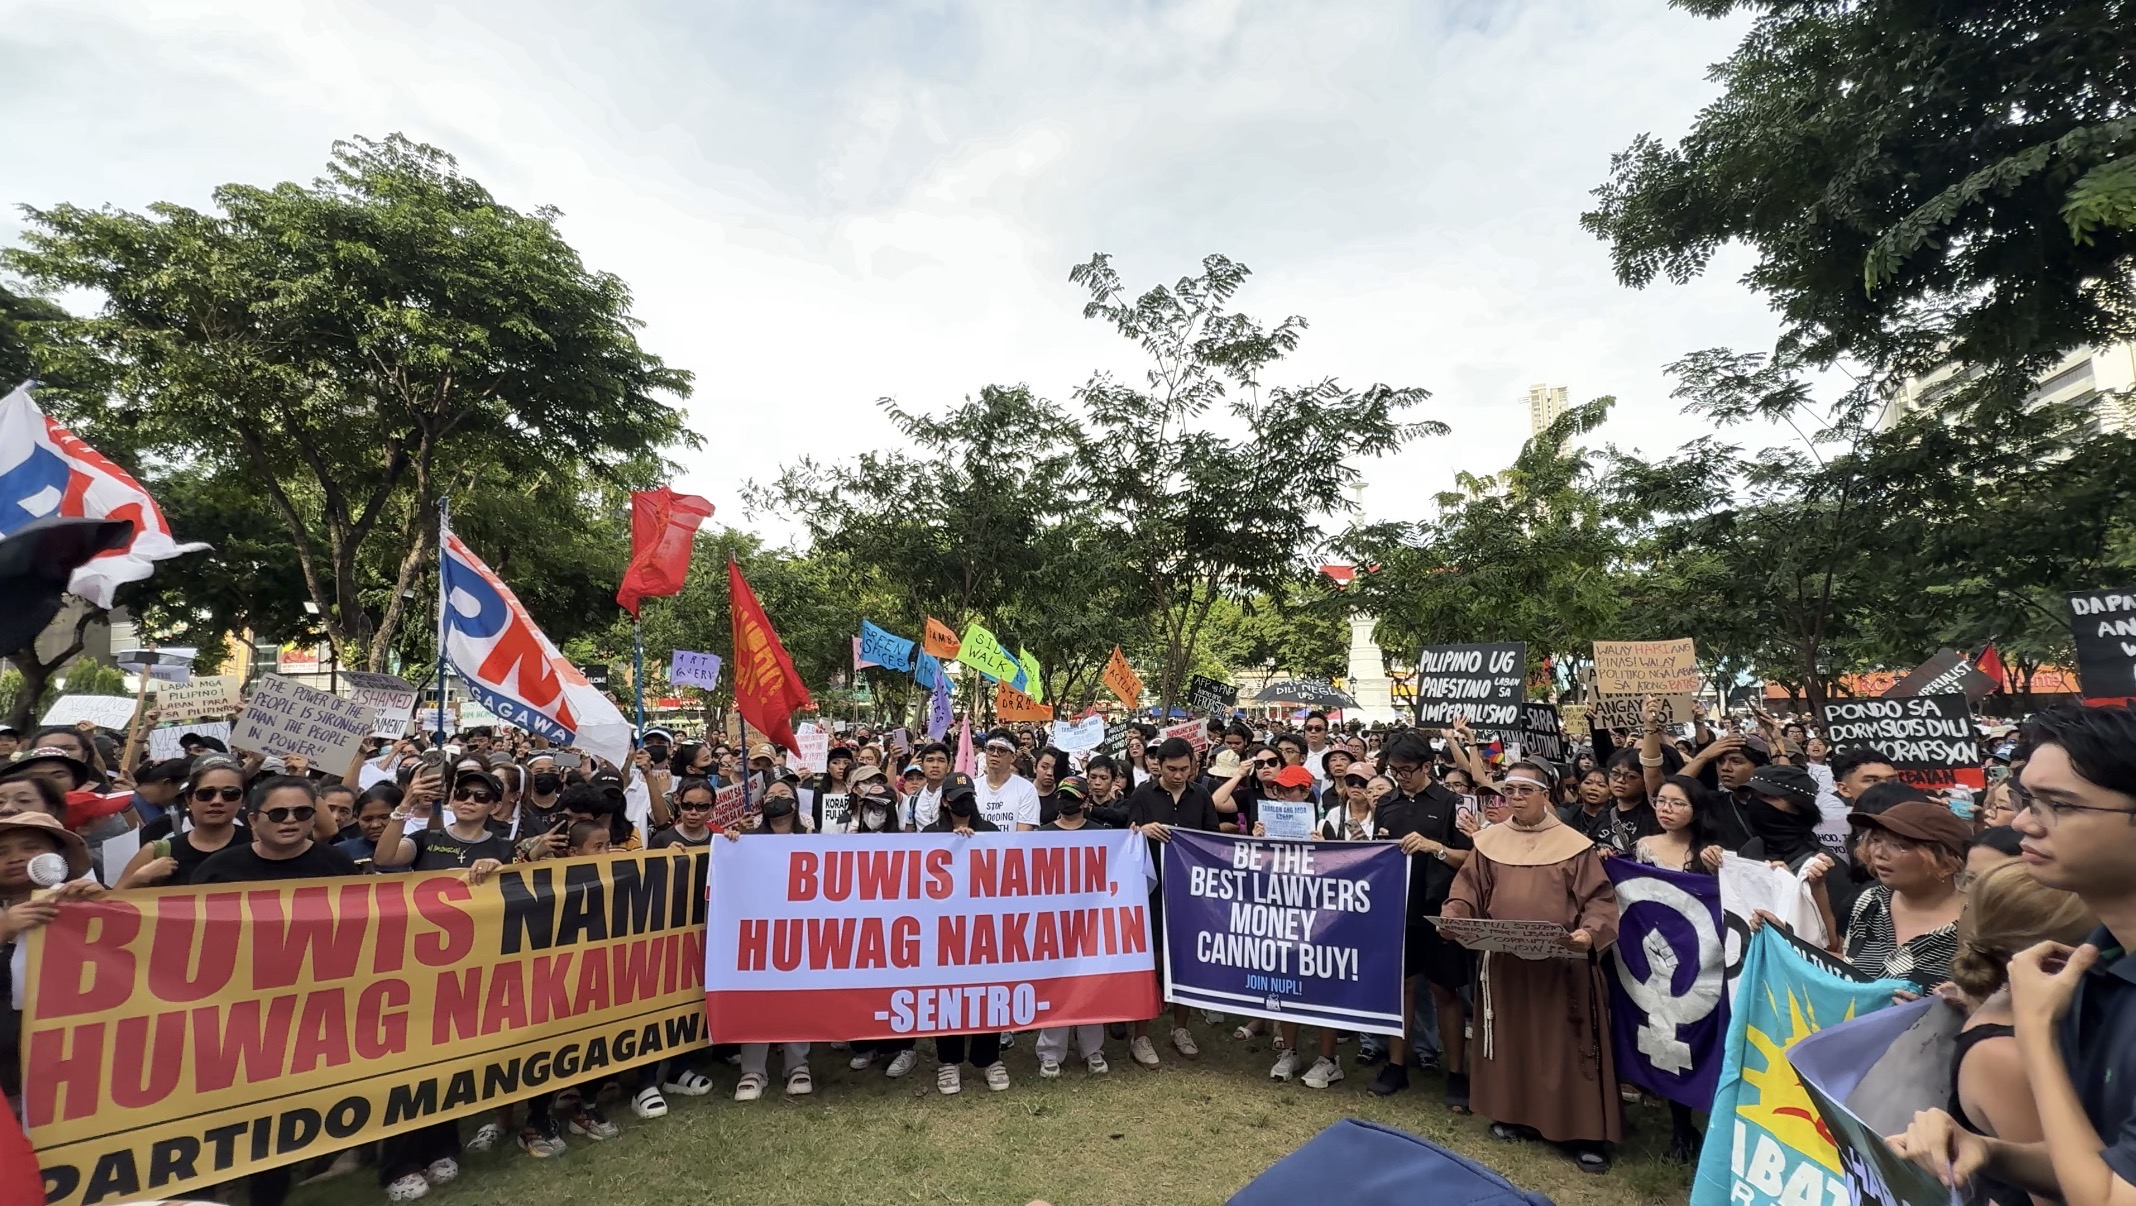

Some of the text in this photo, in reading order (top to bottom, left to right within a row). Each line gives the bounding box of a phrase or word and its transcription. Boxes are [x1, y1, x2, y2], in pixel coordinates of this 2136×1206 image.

[969, 645, 1007, 672] WALK
[1596, 643, 1691, 656] WALAY HARI ANG
[1420, 650, 1516, 674] PILIPINO UG
[1641, 656, 1675, 668] WALAY
[160, 682, 194, 691] LABAN
[1194, 676, 1211, 687] AFP
[1219, 684, 1235, 696] PNP
[1420, 676, 1492, 699] PALESTINO
[1494, 677, 1520, 687] LABAN
[1498, 686, 1511, 698] SA
[1613, 680, 1631, 691] SA
[160, 698, 228, 710] LABAN PARA
[264, 677, 366, 719] THE POWER OF THE
[351, 689, 413, 710] ASHAMED
[1594, 700, 1643, 716] ANGAY
[254, 692, 368, 737] PEOPLE IS STRONGER
[1602, 710, 1674, 728] MASUO!
[1824, 699, 1942, 722] PONDO SA
[246, 707, 350, 748] THAN THE PEOPLE
[248, 726, 263, 740] IN
[1926, 717, 1969, 738] DILI
[1869, 739, 1980, 766] KORAPSYON
[986, 801, 1003, 810] STOP
[1233, 842, 1316, 875] BE THE
[786, 845, 1119, 902] BUWIS NAMIN,
[1190, 865, 1371, 913] BEST LAWYERS
[1229, 902, 1317, 942] MONEY
[34, 876, 477, 1020] BUWIS
[736, 905, 1148, 972] HUWAG NAKAWIN
[1196, 931, 1359, 981] CANNOT BUY!
[1245, 974, 1303, 996] JOIN NUPL!
[873, 982, 1051, 1033] -SENTRO-
[27, 930, 708, 1129] HUWAG NAKAWIN
[383, 1010, 709, 1127] MANGGAGAW
